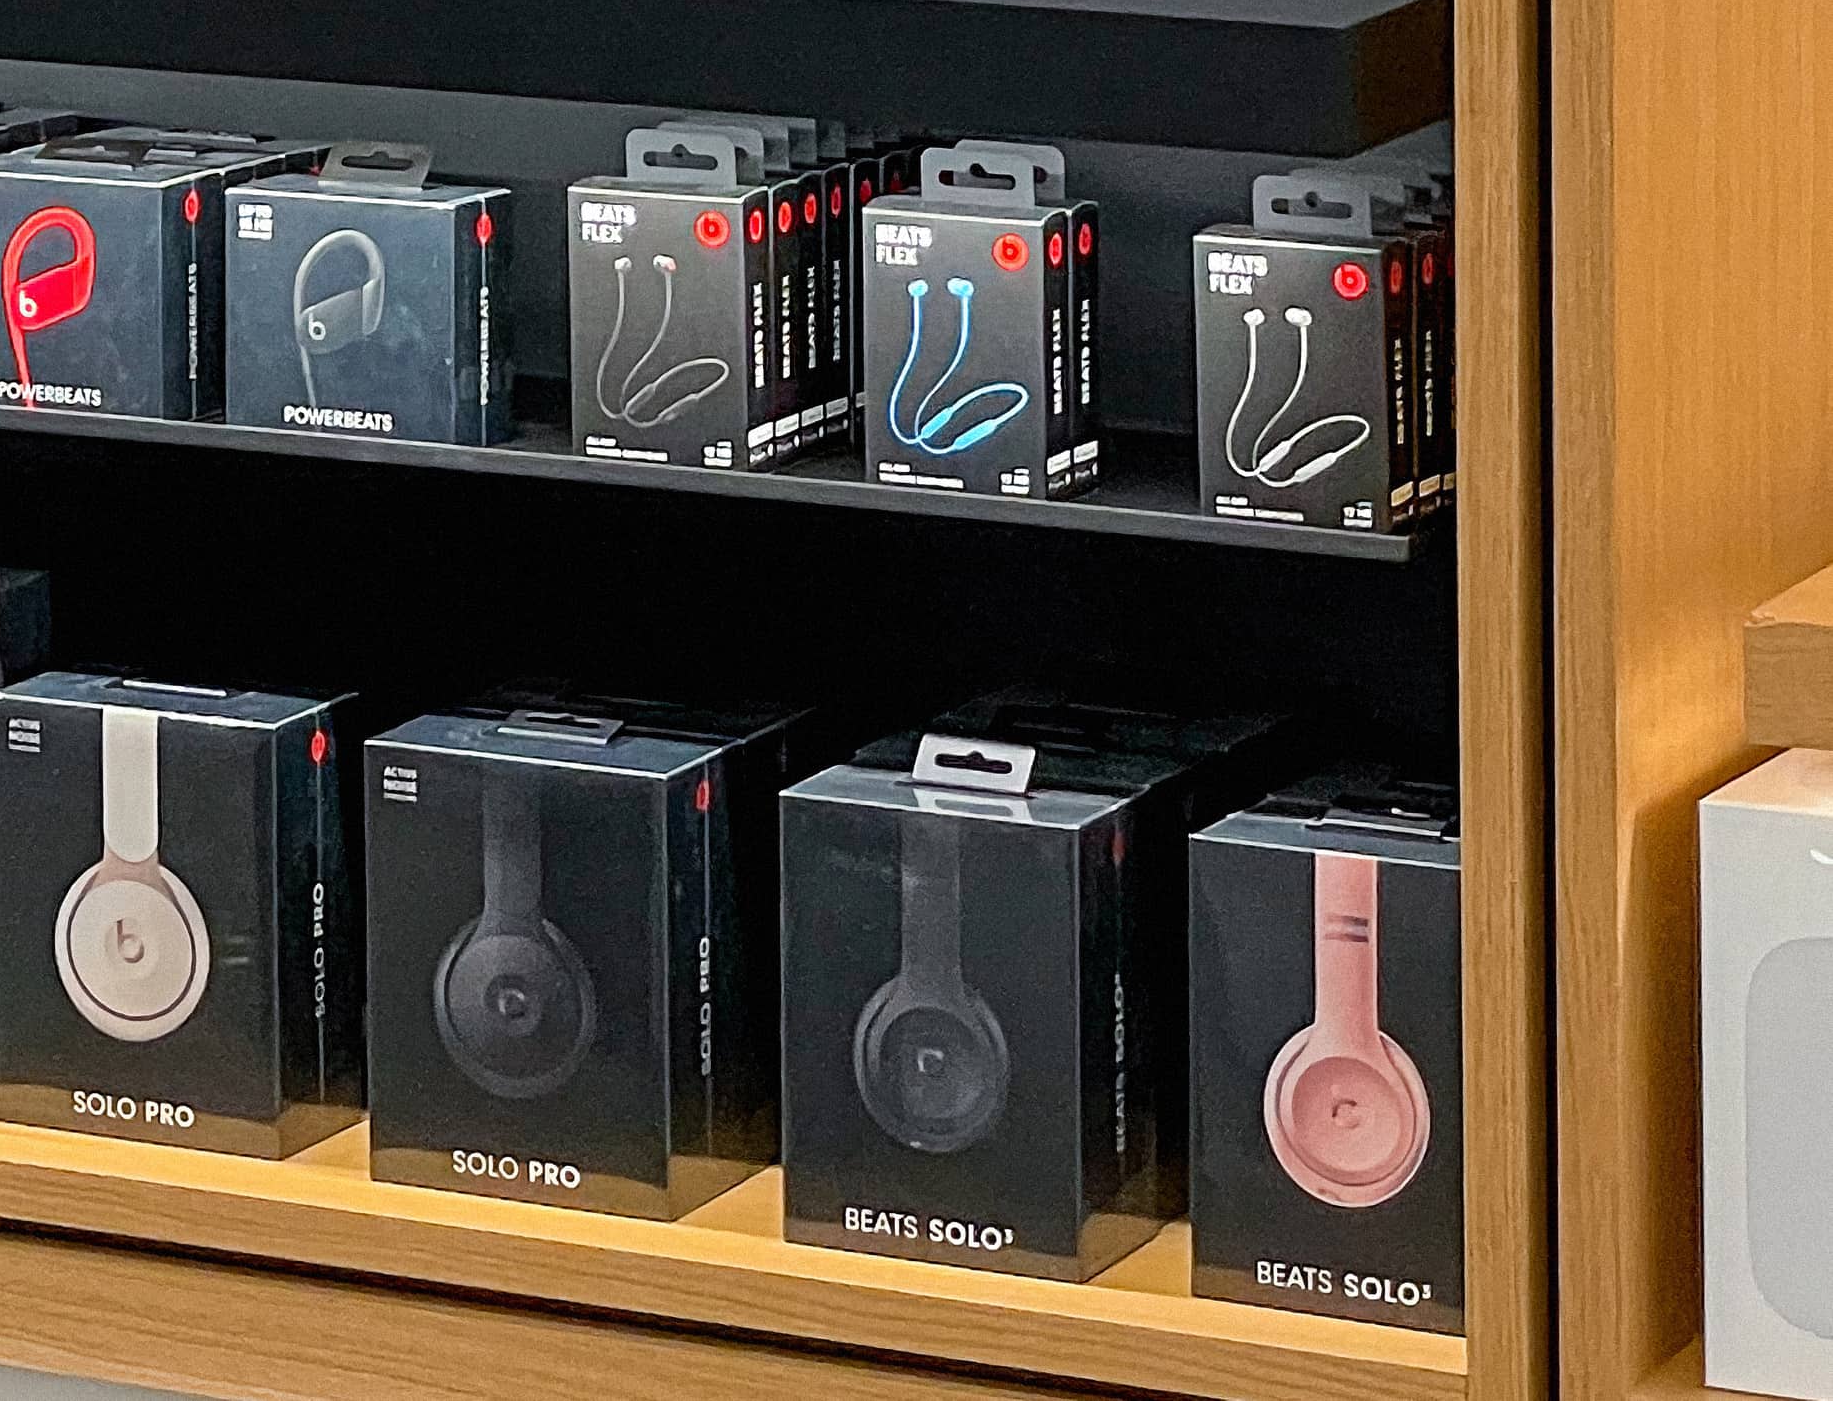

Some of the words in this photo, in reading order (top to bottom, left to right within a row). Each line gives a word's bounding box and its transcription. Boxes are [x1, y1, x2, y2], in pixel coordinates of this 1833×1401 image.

[580, 201, 637, 226] BEATS
[581, 221, 623, 244] FLEX
[874, 222, 933, 247] BEATS
[875, 242, 918, 266] FLEX
[1207, 250, 1269, 277] BEATS
[1208, 273, 1253, 296] FLEX
[283, 405, 393, 433] POWERBEATS
[72, 1091, 137, 1120] SOLO
[145, 1099, 195, 1129] PRO
[452, 1149, 519, 1181] SOLO
[528, 1160, 581, 1190] PRO
[844, 1206, 918, 1239] BEATS
[1256, 1260, 1332, 1294] BEATS
